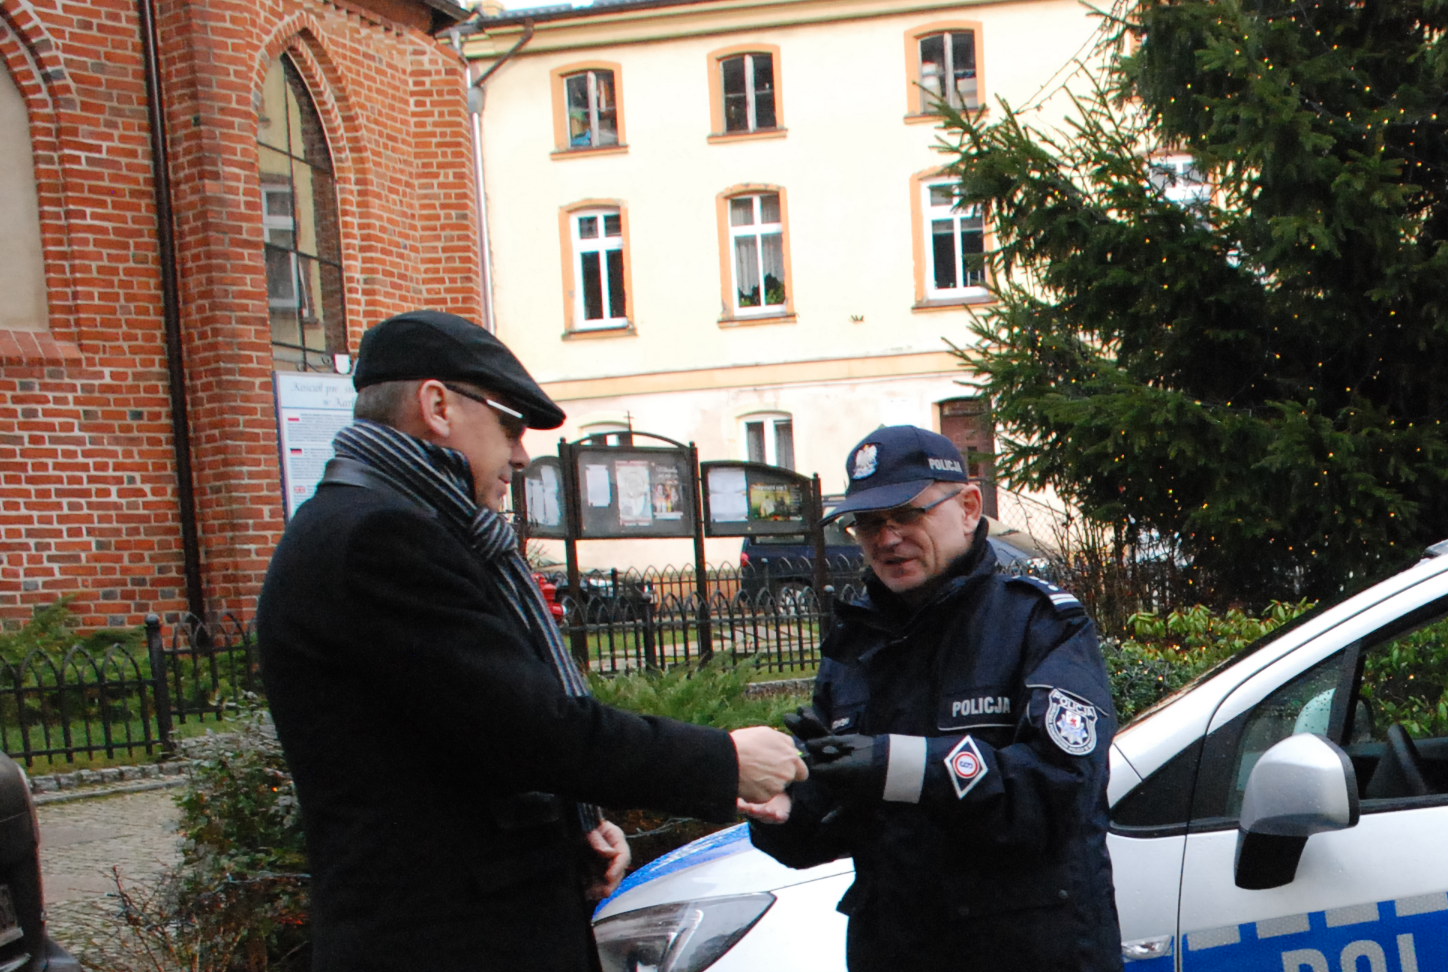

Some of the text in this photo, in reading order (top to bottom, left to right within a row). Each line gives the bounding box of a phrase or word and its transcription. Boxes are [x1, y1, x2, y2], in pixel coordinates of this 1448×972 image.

[928, 457, 963, 473] POLICJA
[952, 696, 1011, 718] POLICJA
[1051, 690, 1095, 719] POLICJA
